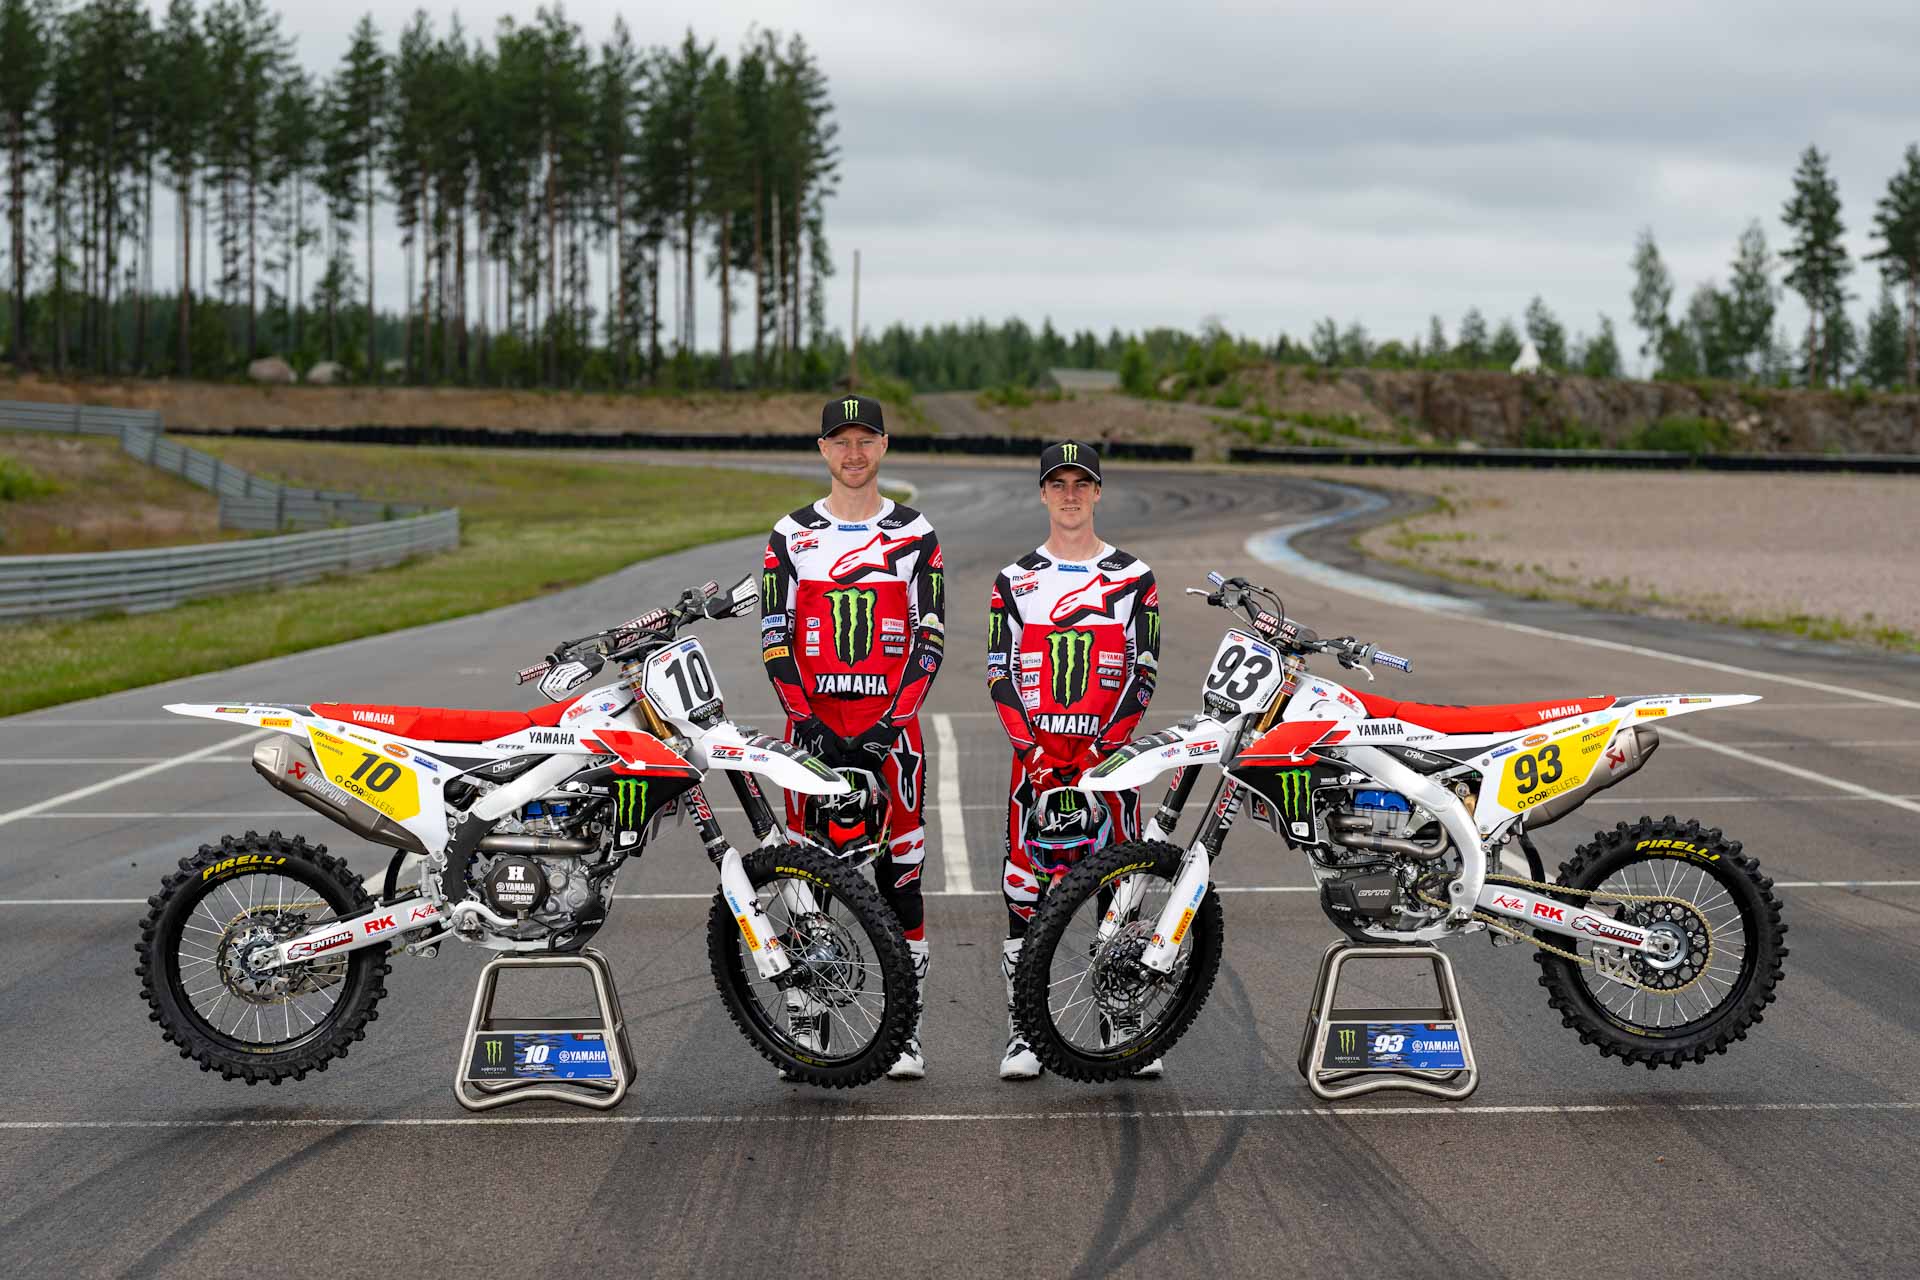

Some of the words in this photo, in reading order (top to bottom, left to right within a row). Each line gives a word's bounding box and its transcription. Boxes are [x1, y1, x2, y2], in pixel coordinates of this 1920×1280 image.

[664, 650, 715, 712] 10
[1206, 644, 1273, 702] 93
[815, 674, 888, 695] YAMAHA
[353, 710, 396, 726] YAMAHA
[692, 700, 722, 718] MONSTER
[1538, 704, 1582, 720] YAMAHA
[1033, 714, 1100, 736] YAMAHA
[1357, 723, 1404, 737] YAMAHA
[1581, 726, 1610, 742] MXGP
[529, 731, 575, 746] YAMAHA
[1581, 742, 1602, 755] GEERTS
[350, 752, 402, 793] 10
[1514, 744, 1563, 795] 93
[344, 780, 395, 815] CORPELLETS
[1527, 775, 1581, 805] CORPELLETS
[1635, 839, 1721, 861] PIRELLI
[202, 855, 287, 880] PIRELLI
[505, 882, 536, 892] YAMAHA
[1533, 902, 1565, 922] RK
[364, 914, 397, 934] RK
[1373, 1034, 1405, 1053] 93
[1423, 1041, 1460, 1050] YAMAHA
[523, 1045, 550, 1064] 10
[570, 1051, 607, 1061] YAMAHA
